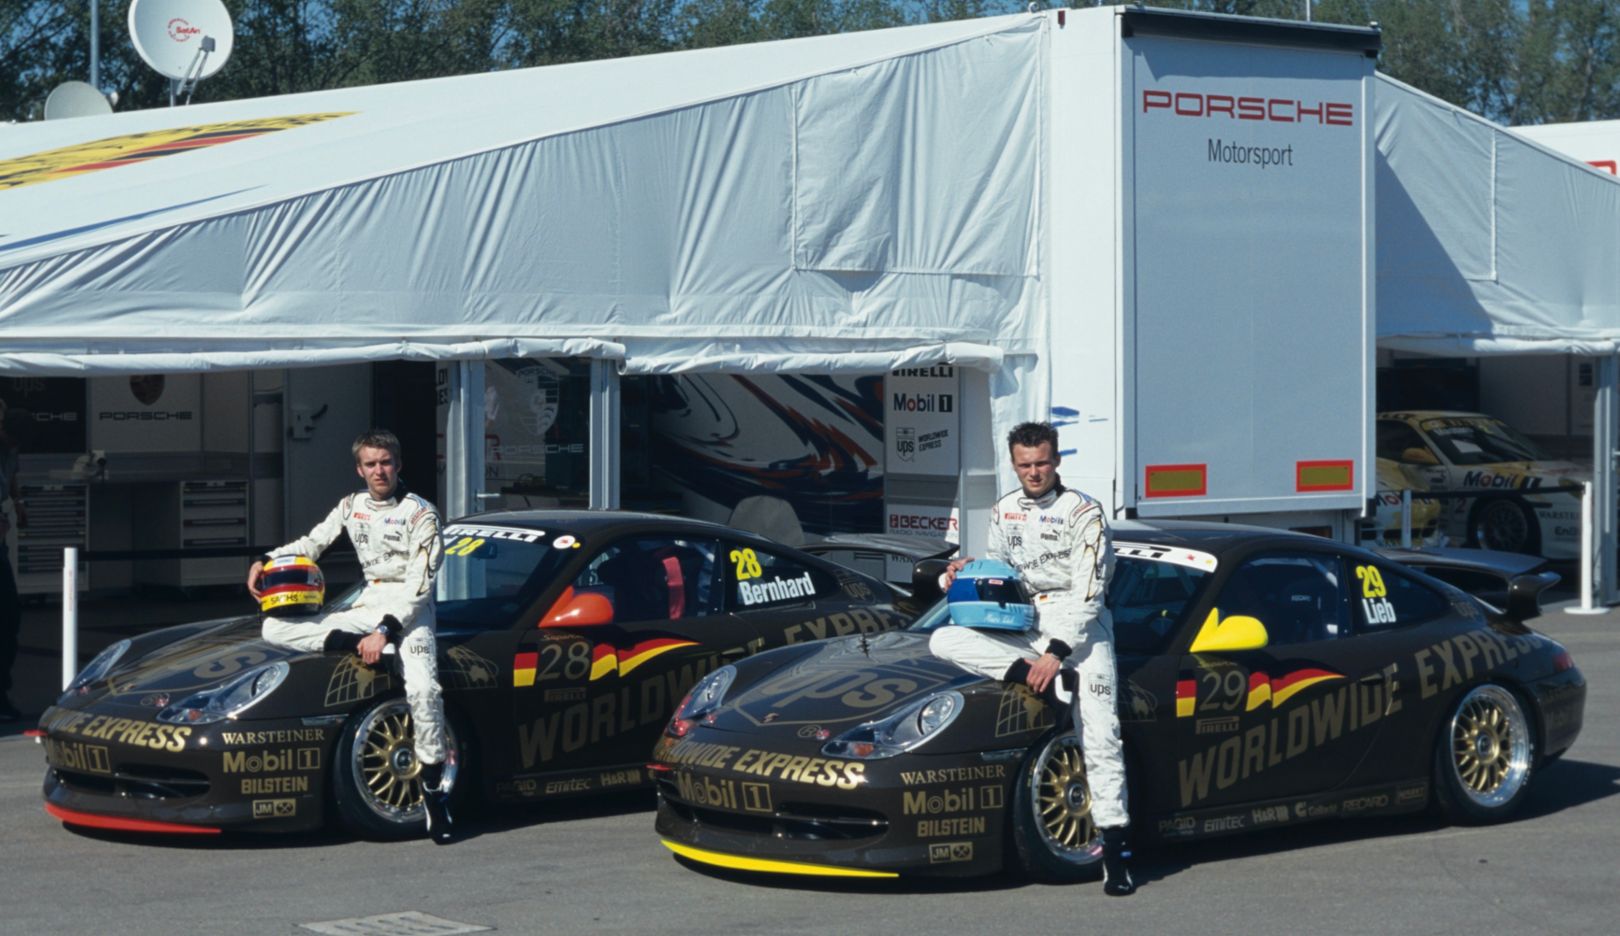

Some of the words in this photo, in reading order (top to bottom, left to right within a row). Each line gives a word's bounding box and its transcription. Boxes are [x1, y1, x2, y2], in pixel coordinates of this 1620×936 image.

[1143, 90, 1353, 126] PORSCHE
[1208, 138, 1294, 169] Motorsport
[894, 393, 935, 412] Mobil
[99, 411, 193, 421] PORSCHE
[897, 440, 914, 457] ups
[1463, 471, 1518, 488] Mobil
[900, 515, 958, 530] BECKER
[444, 536, 486, 556] 28
[1007, 534, 1023, 549] ups
[729, 548, 763, 581] 28
[738, 571, 816, 606] Bernhard
[1355, 565, 1387, 598] 29
[1362, 597, 1397, 624] Lieb
[537, 641, 590, 681] 28
[1090, 684, 1111, 697] ups
[1199, 670, 1247, 711] 29
[82, 715, 193, 753] EXPRESS
[1178, 662, 1403, 808] WORLDWIDE
[1195, 715, 1240, 735] PIRELLI
[222, 729, 325, 745] WARSTEINER
[223, 749, 293, 774] Mobil
[733, 749, 866, 790] EXPRESS
[241, 776, 308, 794] BILSTEIN
[901, 765, 1006, 785] WARSTEINER
[677, 770, 737, 809] Mobil
[255, 802, 273, 815] JM
[903, 788, 974, 815] Mobil
[917, 817, 986, 838] BILSTEIN
[932, 847, 950, 860] JM
